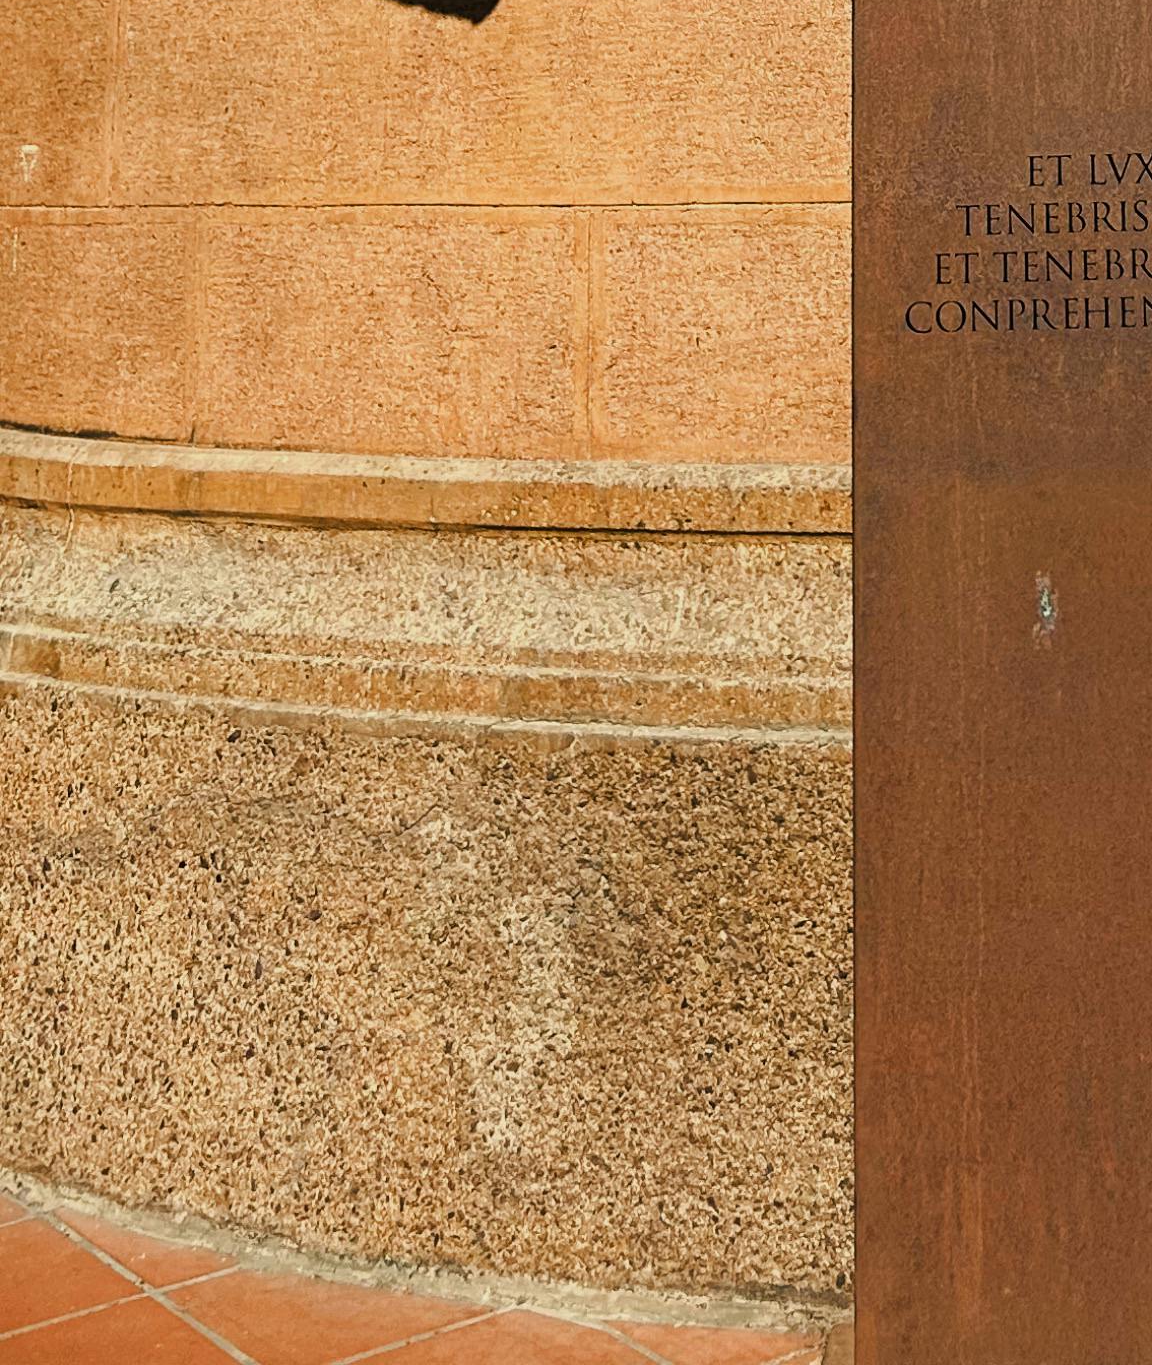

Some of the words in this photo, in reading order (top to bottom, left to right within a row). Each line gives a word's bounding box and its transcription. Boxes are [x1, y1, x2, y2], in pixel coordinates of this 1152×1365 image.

[1027, 154, 1072, 187] ET
[956, 199, 1150, 236] TENEBRIS
[935, 252, 979, 284] ET
